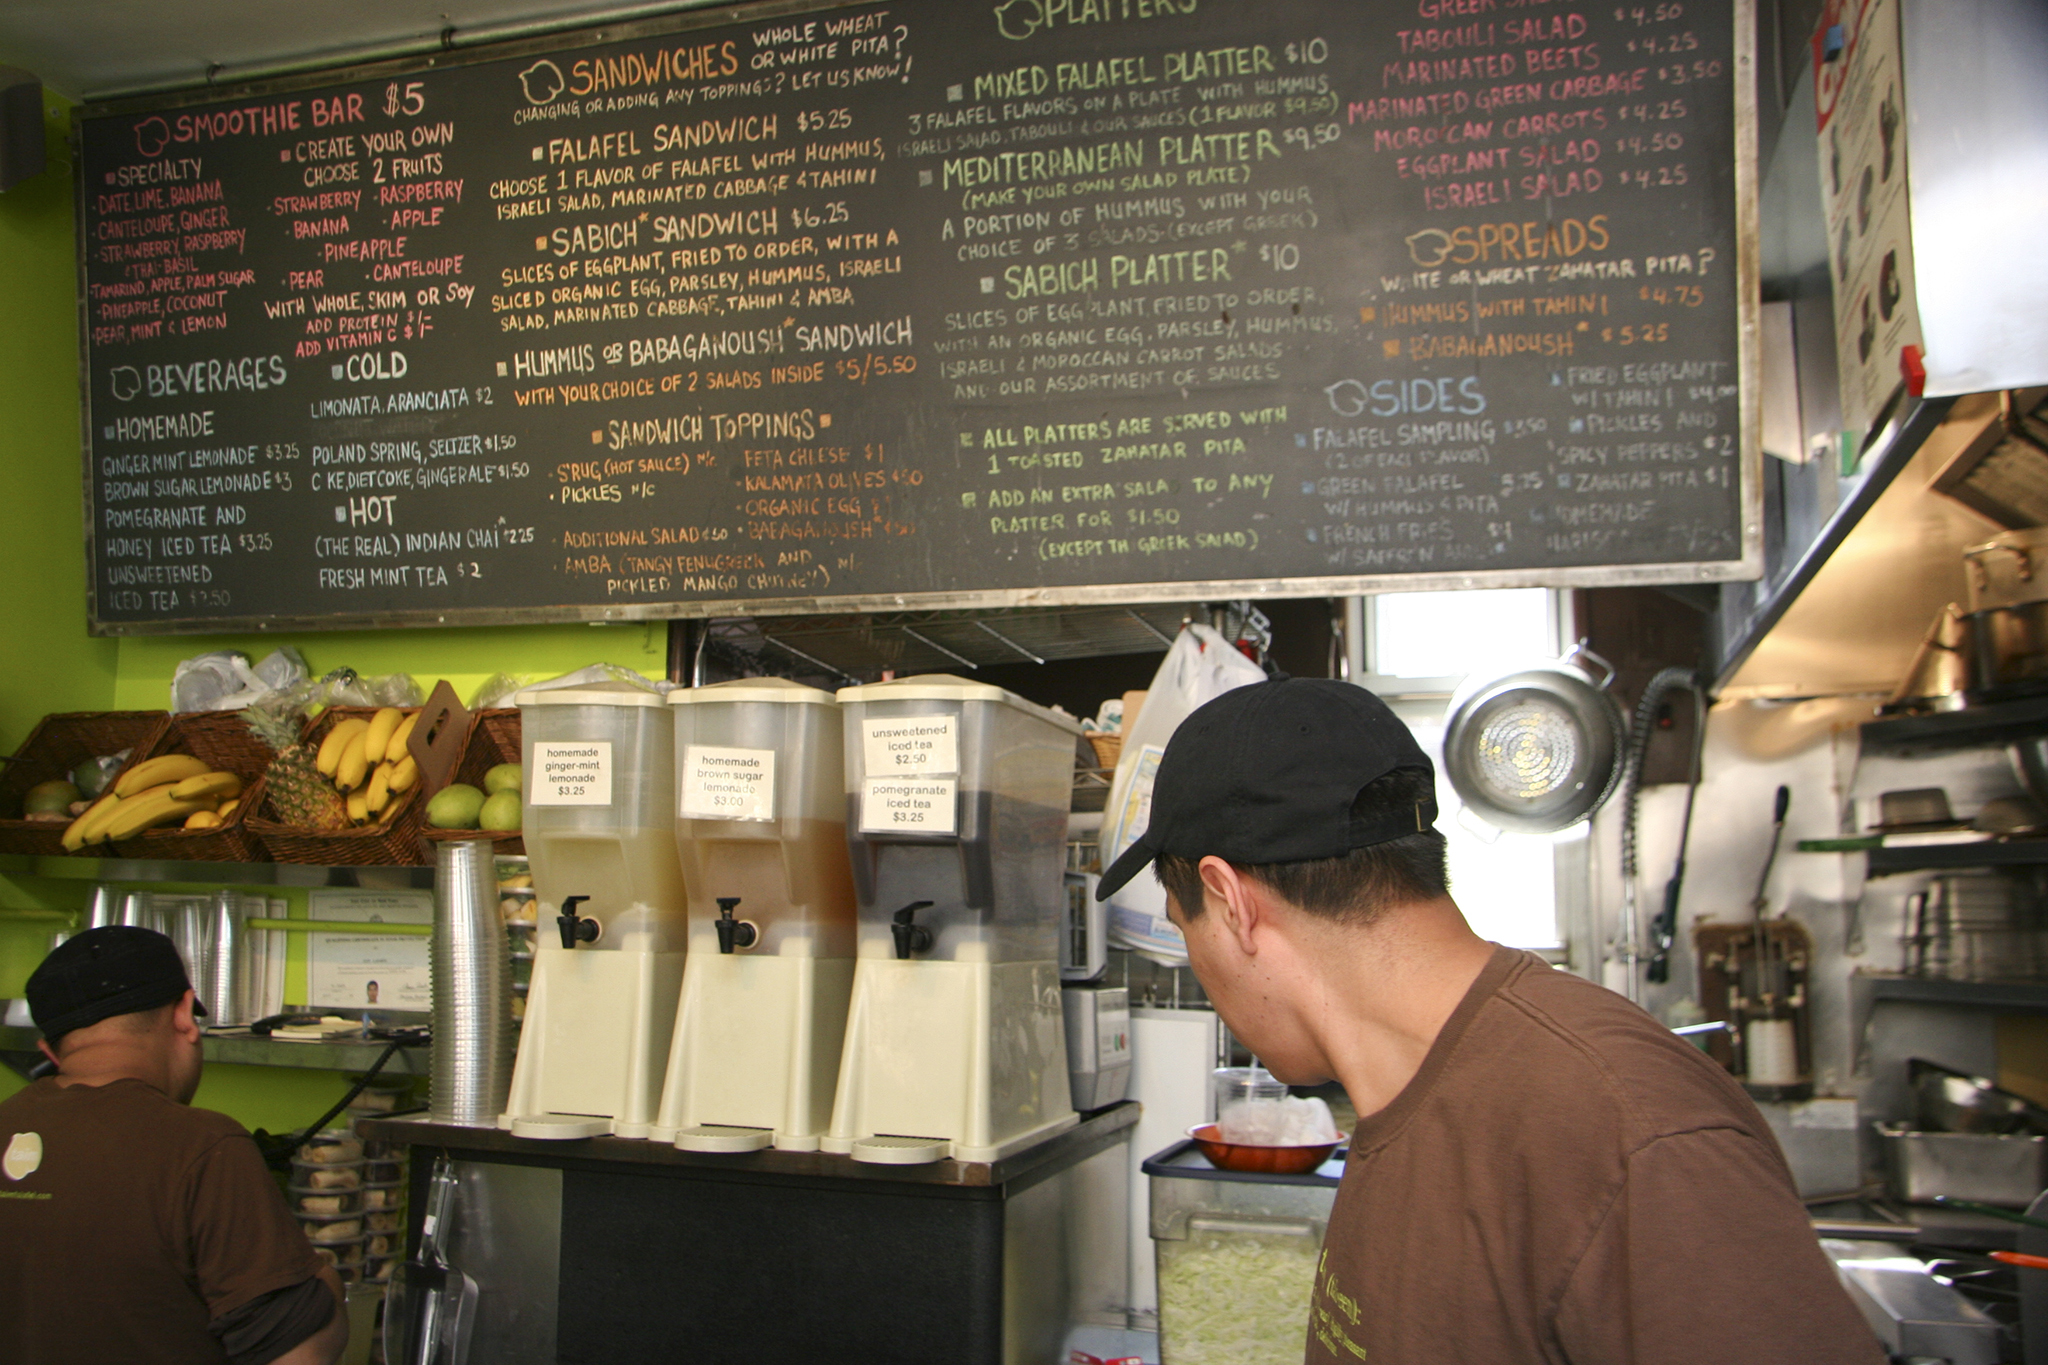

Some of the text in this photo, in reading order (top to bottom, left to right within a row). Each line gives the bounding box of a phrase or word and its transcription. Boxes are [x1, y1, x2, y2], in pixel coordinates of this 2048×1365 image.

[752, 11, 890, 47] WHOLE WHEAT
[1396, 22, 1495, 54] TABOULI
[1503, 13, 1587, 45] SALAD
[569, 40, 739, 95] SANDWICHES
[751, 50, 775, 70] OR
[779, 41, 839, 65] WHITE
[974, 37, 1329, 101] MIXED FALAFEL PLATTER $10
[1382, 53, 1517, 89] MARINATED
[1525, 42, 1601, 75] BEETS
[173, 81, 425, 143] SMOOTHIE BAR $5
[296, 121, 454, 163] CREATE YOUR OWN
[549, 130, 641, 165] FALAFEL
[653, 113, 778, 152] SANDWICH
[1374, 120, 1493, 152] MOROCCAN
[1502, 107, 1608, 140] CARROTS
[118, 157, 202, 187] SPECIALTY
[304, 152, 443, 188] CHOOSE 2 FRUITS
[489, 137, 886, 199] CHOOSE 1 FLAVOR OF FALAFEL WITH HUMMUS,
[943, 122, 1341, 191] MEDITERRANEAN PLATTER $9.50
[274, 178, 464, 215] STRAWBERRY RASPBERRY
[1424, 178, 1512, 211] ISRAELI
[1521, 167, 1602, 200] SALAD
[294, 206, 444, 240] BANANA APPLE
[551, 201, 849, 258] SABICH SANDWICH $6.25
[942, 185, 1313, 241] A PORTION OF HUMMUS WITH YOUR
[324, 236, 408, 263] PINEAPPLE
[1451, 214, 1610, 264] SPREADS
[289, 254, 465, 291] PEAR CANTELOUPE
[501, 227, 900, 288] SLICES OF EGGPLANT, FRIED TO ORDER, WITH A
[1004, 243, 1300, 300] SABICH PLATTER $10
[491, 290, 545, 313] SLICED
[551, 280, 622, 305] ORGANIC
[669, 272, 744, 294] PARSLEY,
[748, 264, 831, 287] HUMMUS,
[839, 255, 901, 277] ISRAELI
[264, 296, 305, 320] WITH
[312, 291, 365, 315] WHOLE,
[368, 290, 407, 310] SKIM
[417, 286, 440, 306] OR
[514, 343, 595, 379] HUMMUS
[629, 326, 784, 367] BABAGANOUSH
[795, 315, 913, 352] SANDWICH
[147, 354, 287, 397] BEVERAGES
[347, 351, 407, 382] COLD
[514, 387, 555, 406] WITH
[559, 382, 600, 406] YOUR
[601, 377, 655, 400] CHOICE
[660, 373, 683, 393] OF
[687, 371, 698, 392] 2
[706, 369, 762, 391] SALADS
[771, 361, 825, 385] INSIDE
[387, 387, 469, 412] ARANCIATA
[475, 386, 494, 405] $2
[1370, 375, 1486, 416] SIDES
[117, 410, 214, 442] HOMEMADE
[608, 408, 815, 450] SANDWICH TOPPINGS
[983, 427, 1019, 449] ALL
[1024, 420, 1112, 446] PLATTERS
[1116, 417, 1151, 437] ARE
[1239, 405, 1287, 425] WITH
[1312, 419, 1496, 451] FALAFEL SAMPLING
[102, 442, 300, 478] GINGER MINT LEMONADE $3.25
[312, 444, 366, 467] POLAND
[429, 434, 483, 459] SELTZER
[484, 434, 516, 452] $1.50
[104, 470, 293, 502] BROWN SUGAR LEMONADE $3
[562, 484, 622, 504] PICKLES
[105, 504, 247, 530] POMEGRANATE AND
[350, 495, 397, 527] HOT
[106, 532, 273, 560] HONEY ICED TEA $3.25
[108, 564, 212, 585] UNSWEETENED
[320, 565, 448, 589] FRESH MINT TEA
[872, 724, 948, 738] unsweetened
[887, 740, 933, 751] iced tea
[545, 760, 600, 772] ginger-mint
[546, 747, 599, 758] homemade
[701, 755, 760, 768] homemade
[895, 753, 927, 766] $2.50
[548, 773, 596, 783] lemonade
[557, 785, 585, 796] $3.25
[697, 768, 764, 783] brown sugar
[702, 780, 756, 794] lemonade
[872, 785, 947, 796] pomegranate
[713, 795, 744, 807] $3.00
[886, 798, 932, 809] iced tea
[892, 811, 924, 823] $3.25
